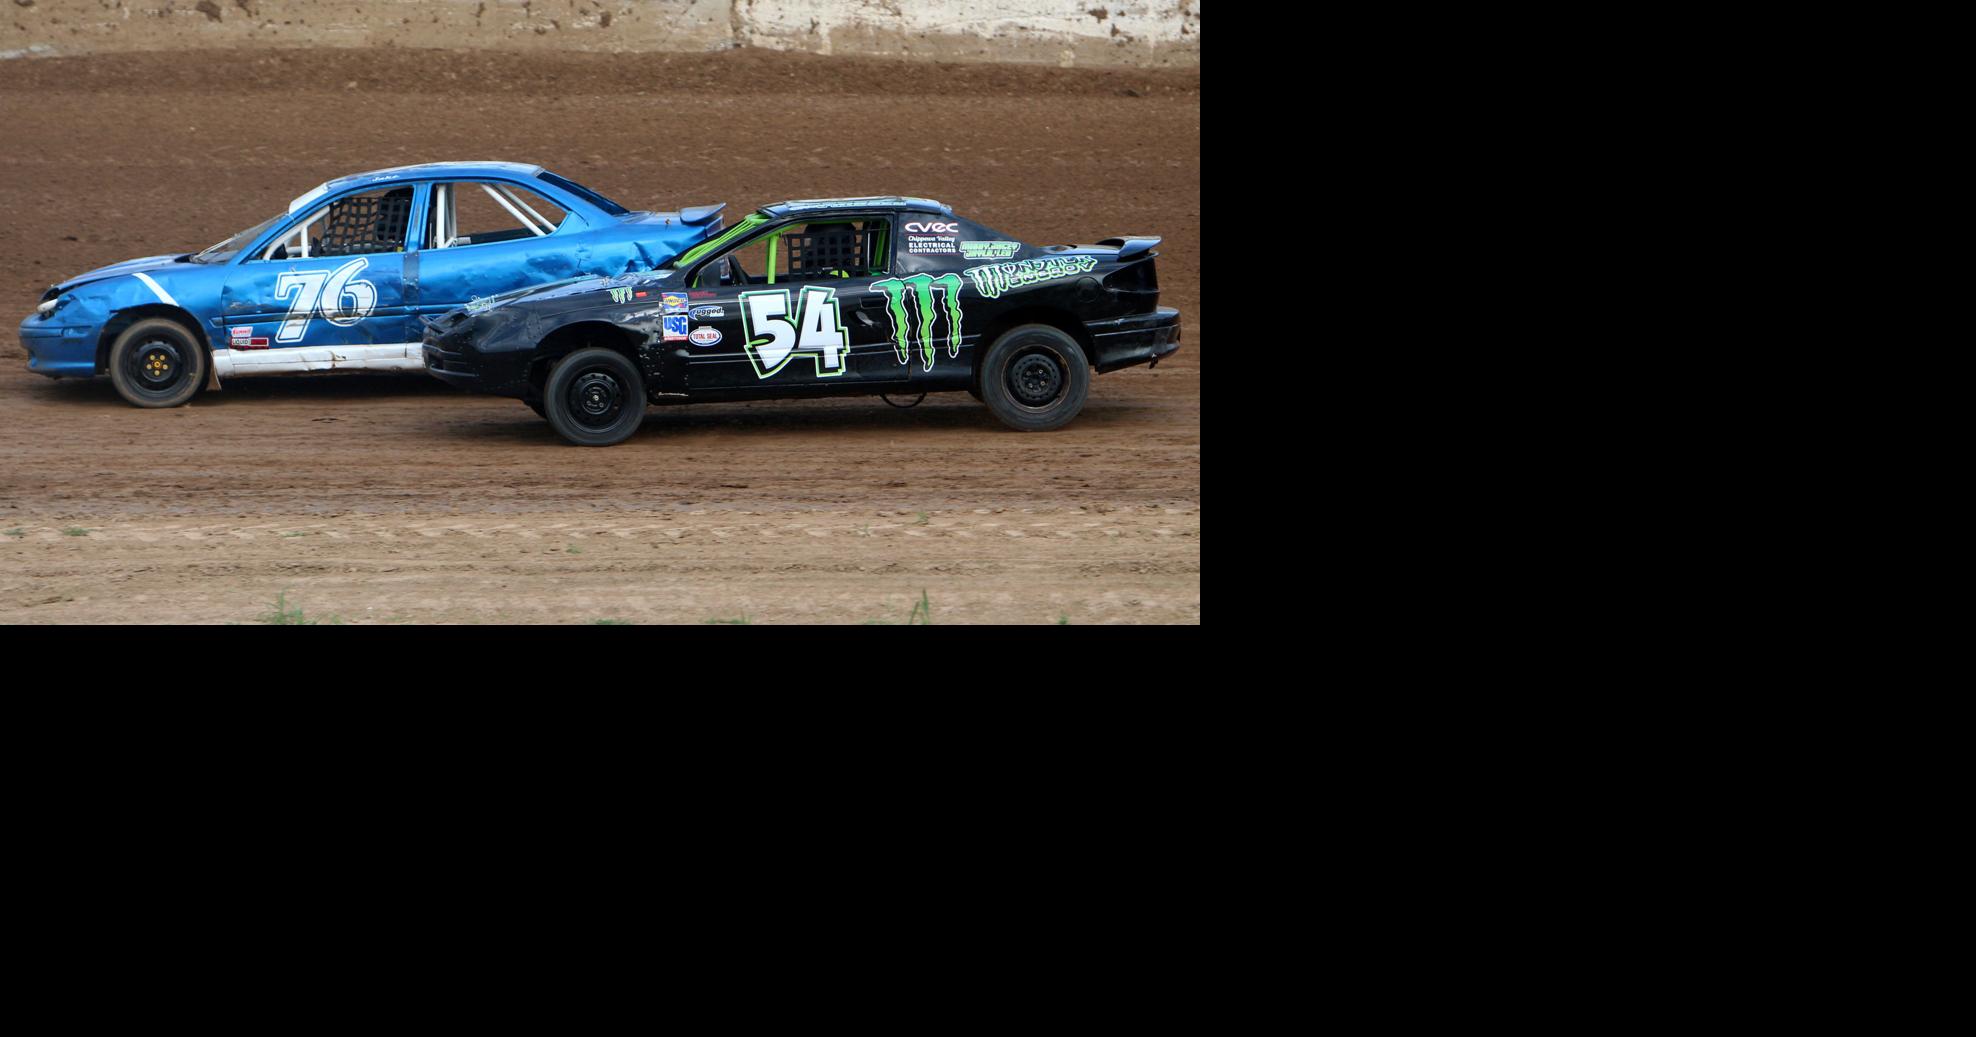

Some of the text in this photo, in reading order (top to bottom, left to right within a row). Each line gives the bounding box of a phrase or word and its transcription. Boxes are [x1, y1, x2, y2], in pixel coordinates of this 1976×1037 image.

[275, 258, 377, 343] 76
[663, 316, 688, 335] USG
[741, 287, 848, 376] 54
